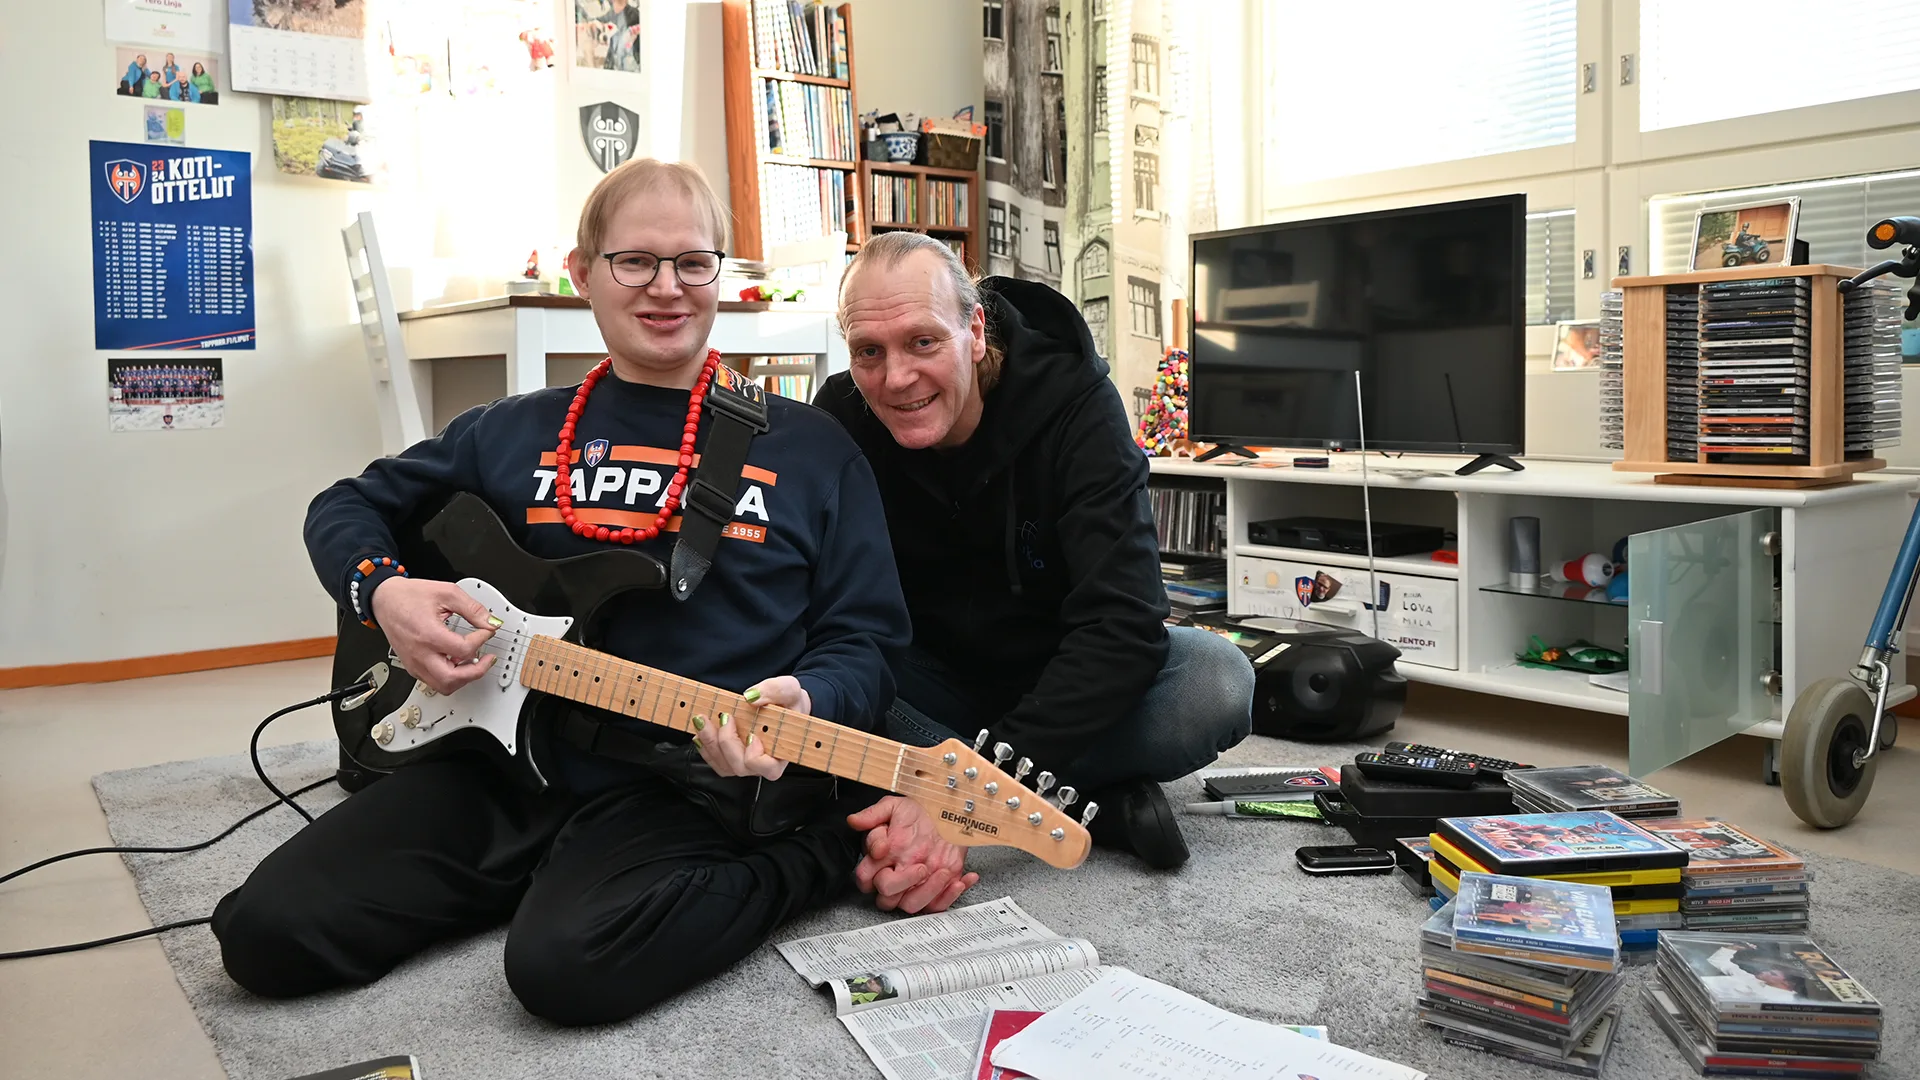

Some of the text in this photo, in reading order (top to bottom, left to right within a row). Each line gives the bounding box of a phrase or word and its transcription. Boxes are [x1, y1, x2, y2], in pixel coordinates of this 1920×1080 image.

[151, 156, 222, 181] 23 KOTI-
[151, 170, 165, 182] 24
[151, 175, 235, 205] OTTELUT
[533, 466, 770, 522] TAPPAA
[732, 526, 761, 539] 1955
[1403, 601, 1433, 614] LOVA
[1402, 617, 1432, 627] MILA
[940, 810, 999, 836] BEHRINGER
